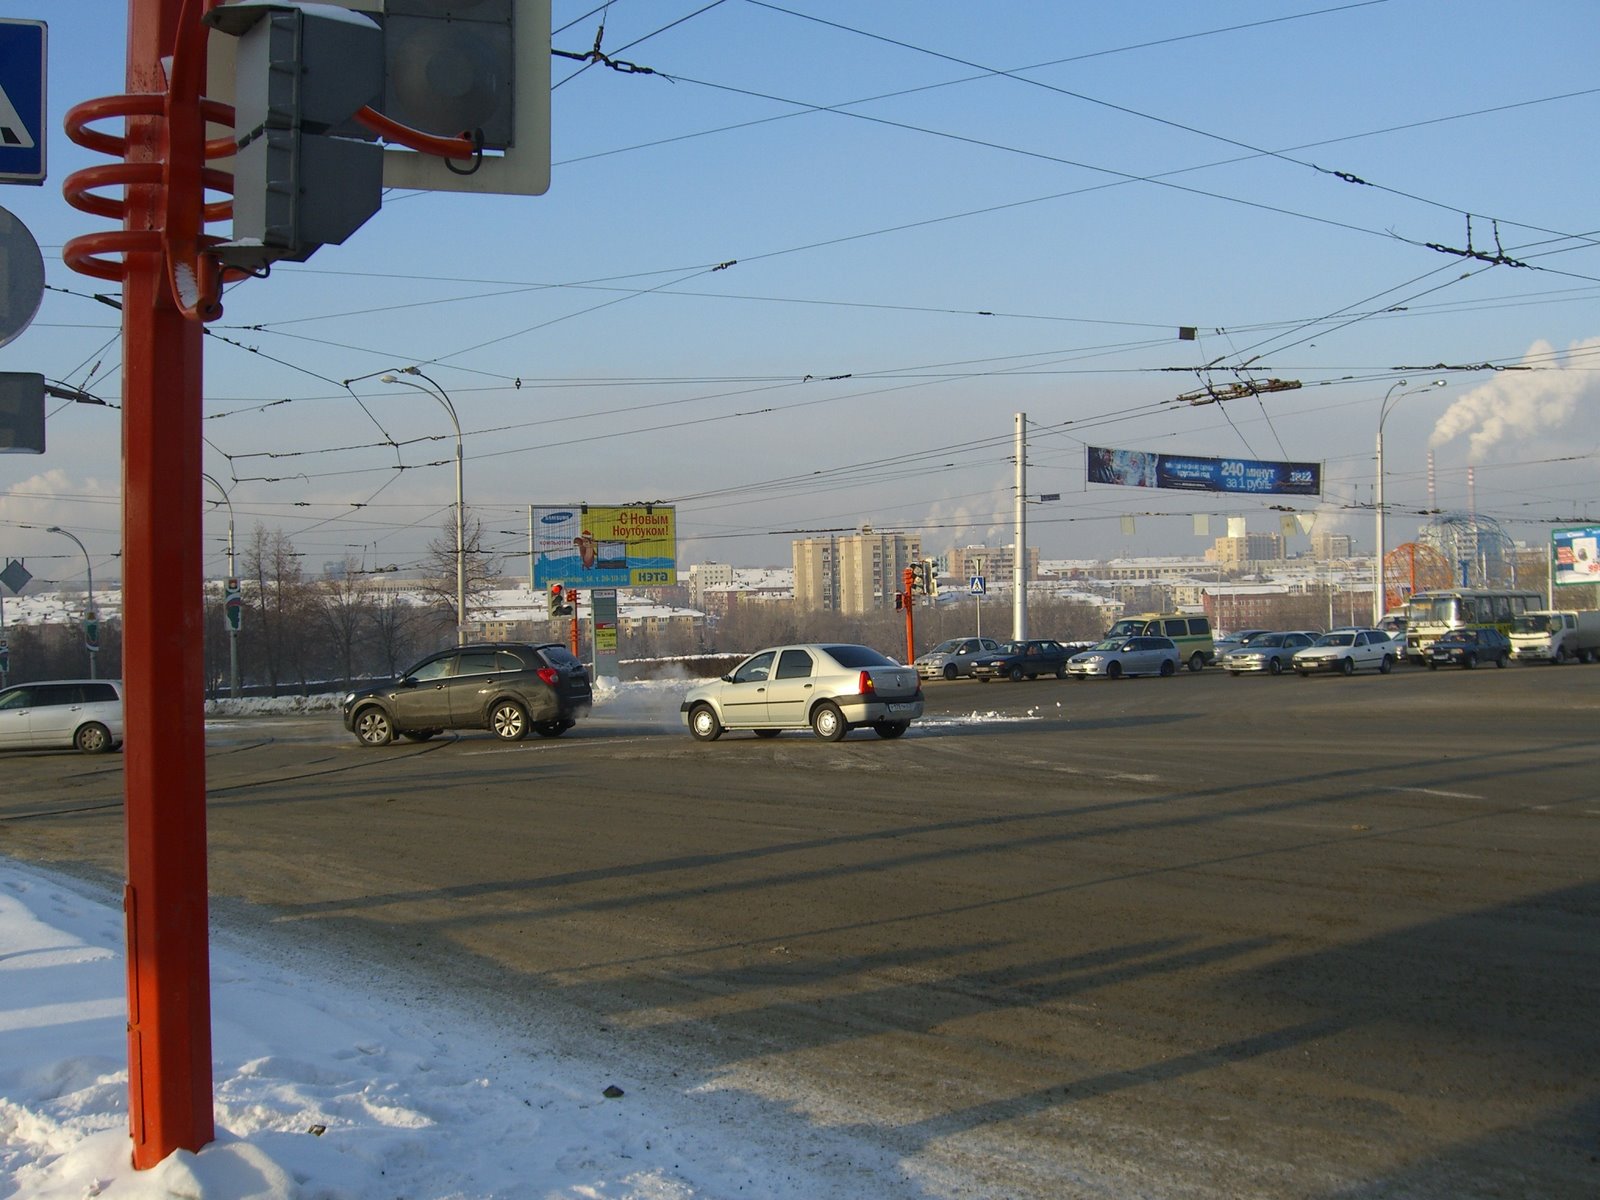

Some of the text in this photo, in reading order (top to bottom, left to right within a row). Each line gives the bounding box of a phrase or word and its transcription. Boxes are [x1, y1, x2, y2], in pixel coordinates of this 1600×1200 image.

[1221, 462, 1275, 480] 240 минут
[1226, 477, 1272, 491] за 1 рубль
[620, 512, 668, 525] С Новым
[612, 524, 669, 538] Ноутбуком!
